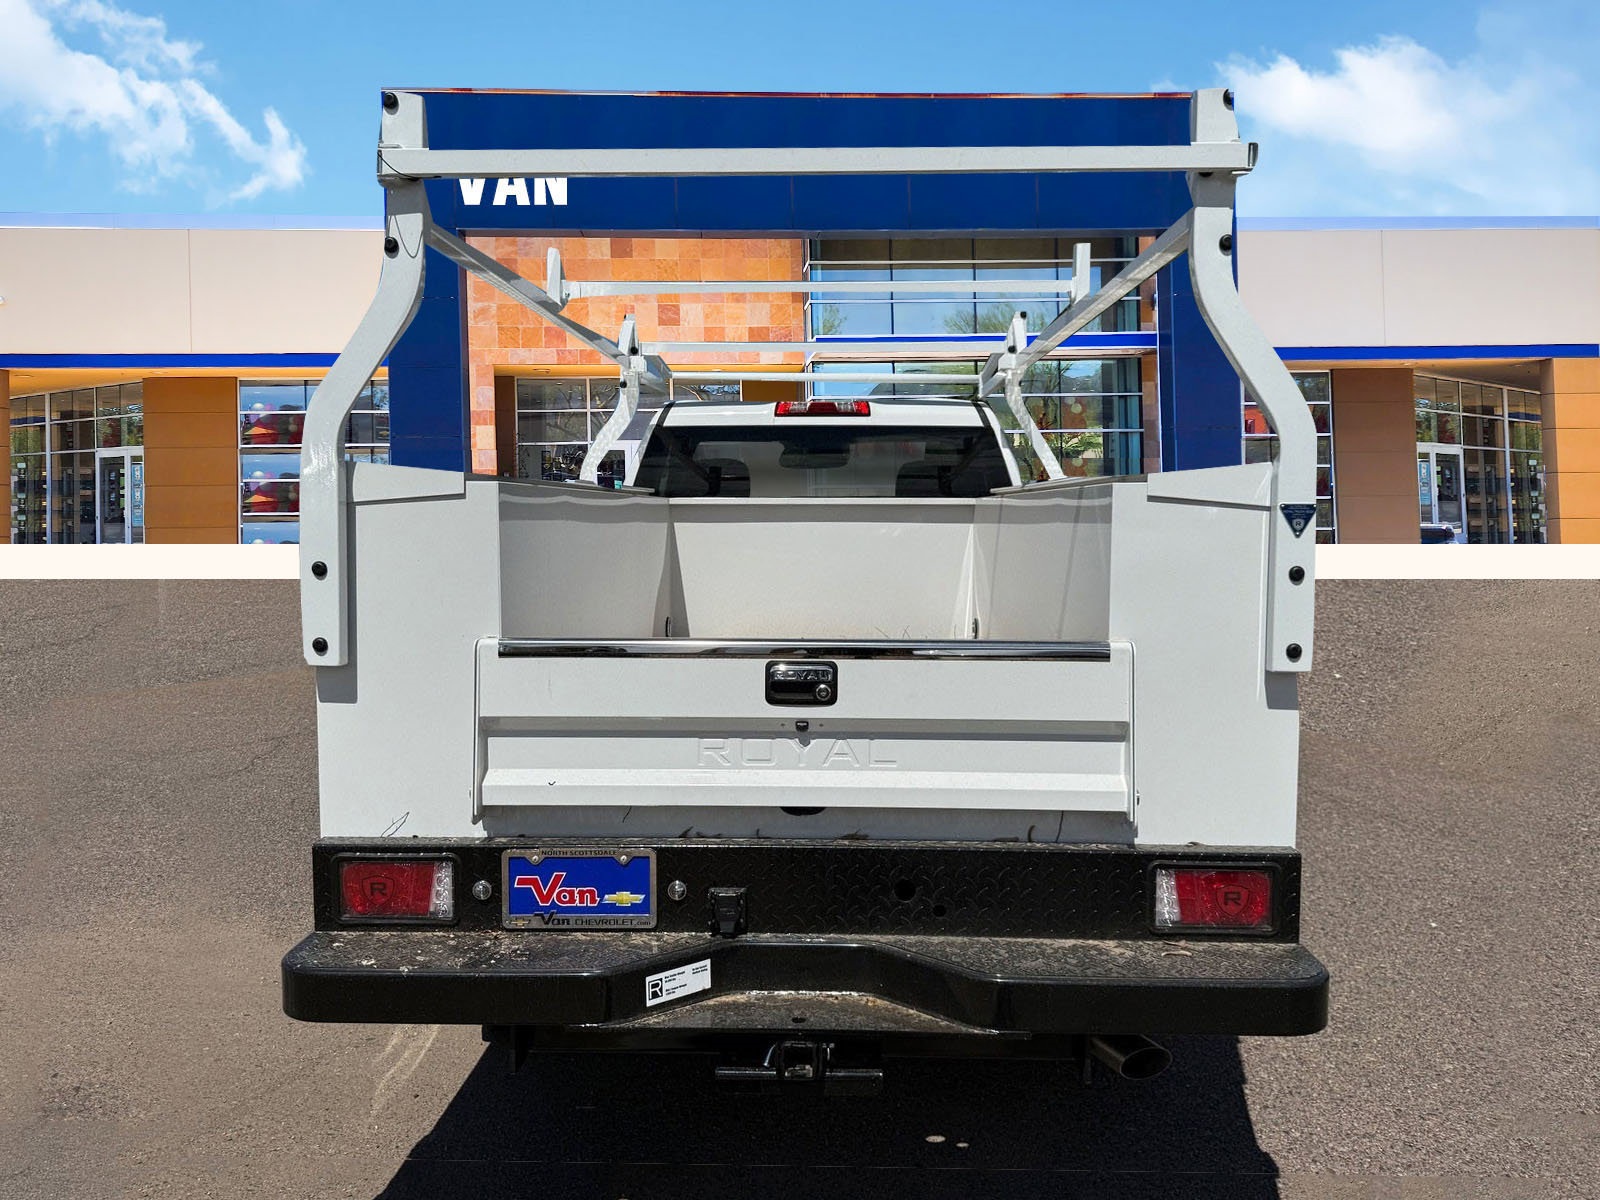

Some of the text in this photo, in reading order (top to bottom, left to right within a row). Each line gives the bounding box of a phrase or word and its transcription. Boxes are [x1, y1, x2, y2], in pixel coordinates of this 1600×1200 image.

[458, 177, 568, 206] VAN
[698, 738, 898, 767] ROYAL
[514, 872, 600, 906] Van
[533, 910, 571, 926] Van
[649, 980, 662, 999] R
